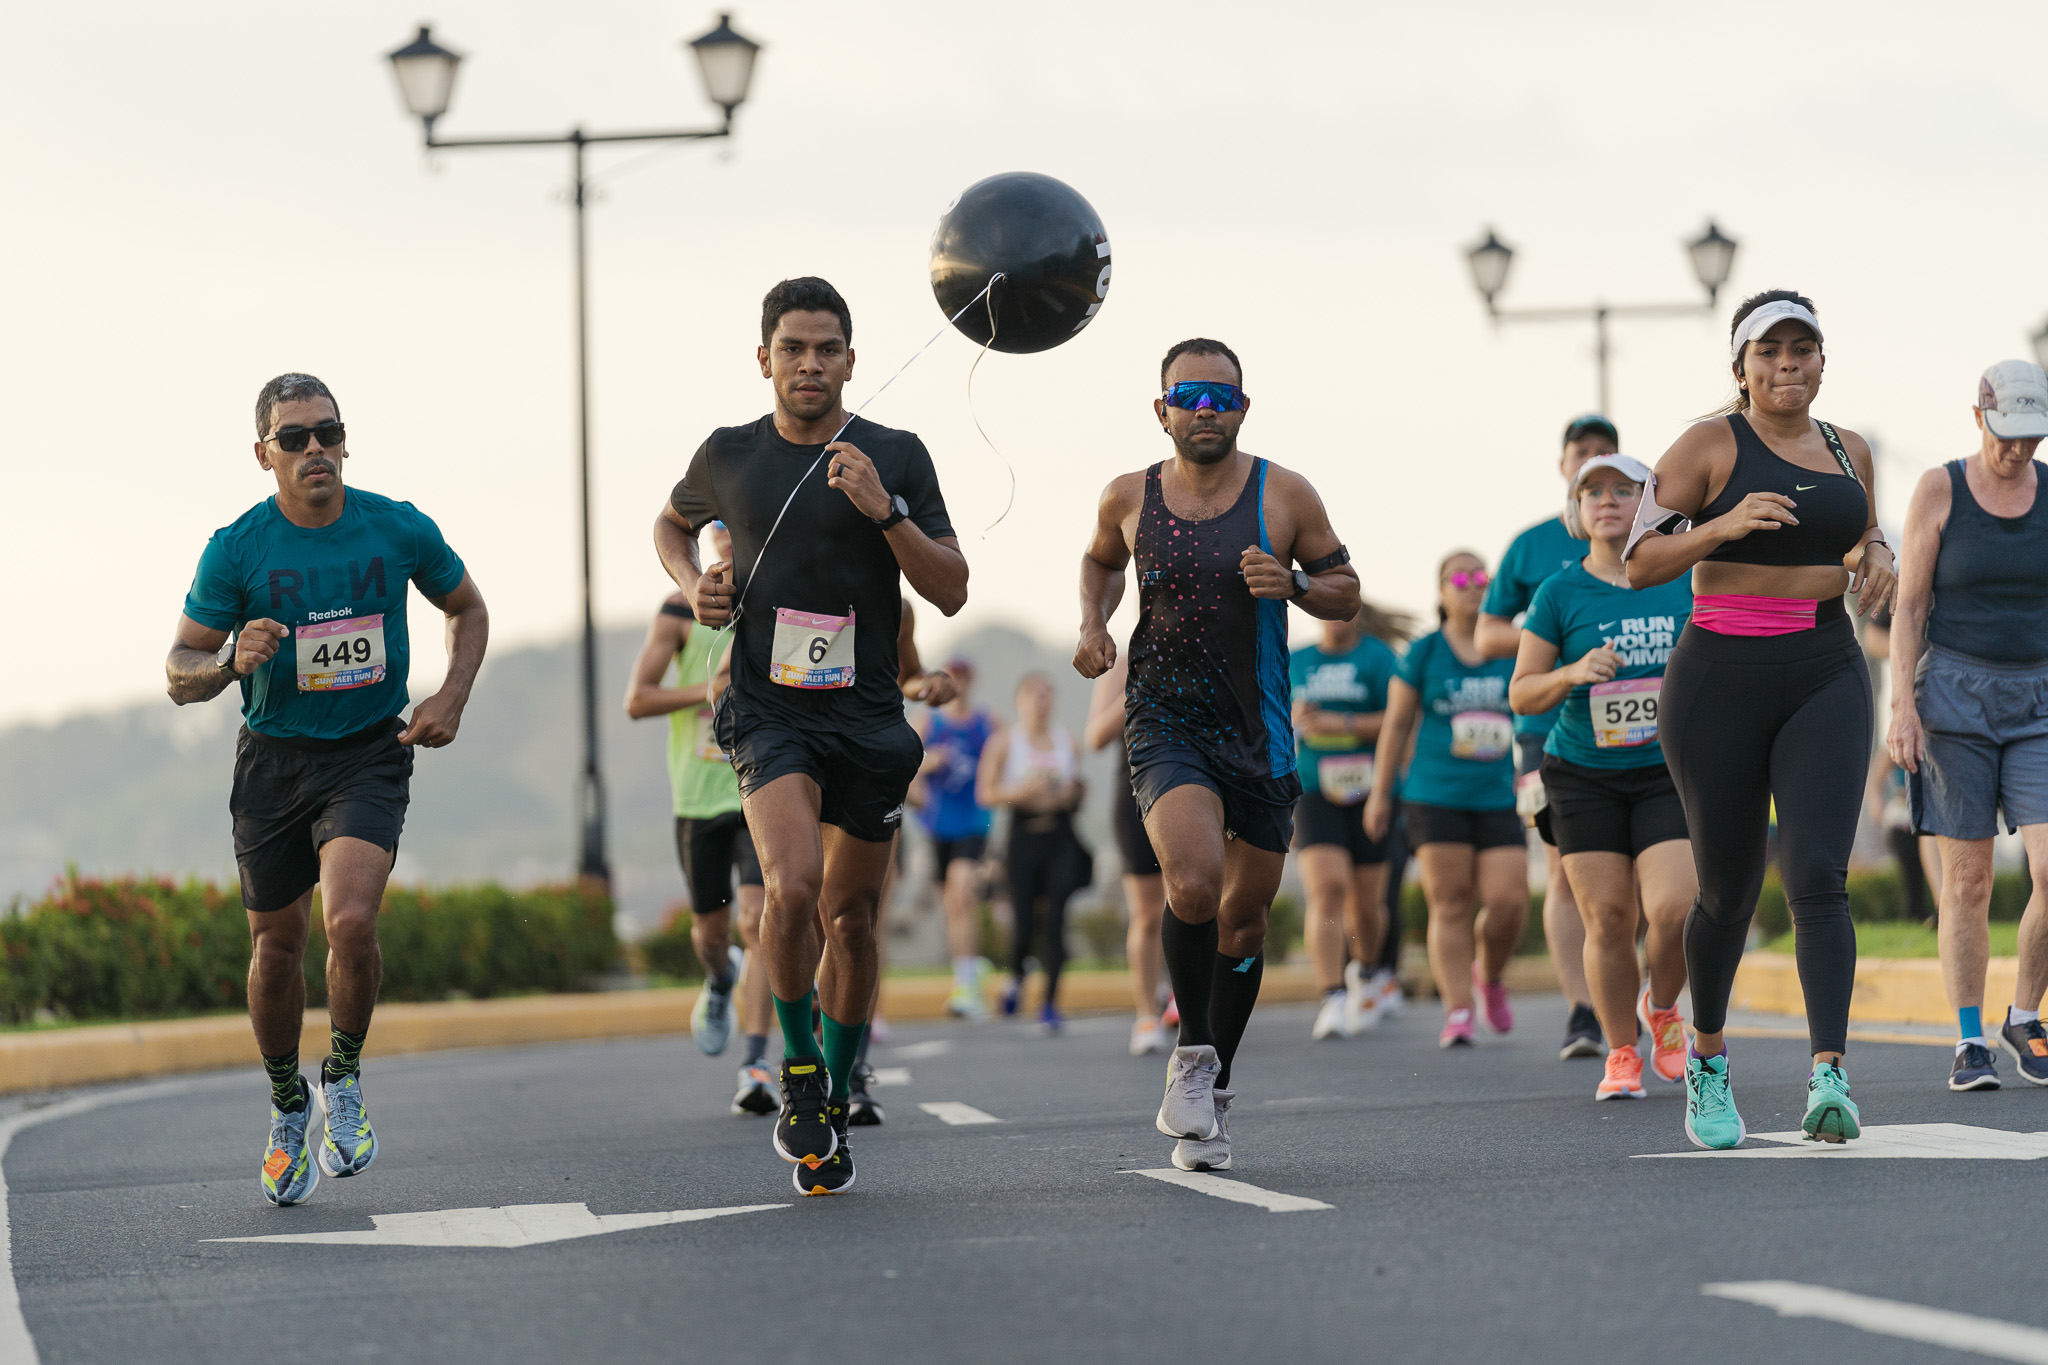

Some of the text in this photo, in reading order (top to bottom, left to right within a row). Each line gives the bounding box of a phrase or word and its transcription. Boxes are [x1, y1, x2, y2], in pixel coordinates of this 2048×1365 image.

[1836, 449, 1857, 480] PRO
[308, 606, 353, 621] Reebok
[1621, 615, 1675, 635] RUN
[808, 636, 829, 665] 6
[1602, 631, 1673, 652] YOUR
[311, 637, 371, 668] 449
[314, 674, 353, 685] SUMMER
[354, 671, 371, 681] RUN
[785, 670, 824, 683] SUMMER
[824, 673, 841, 682] RUN
[1605, 698, 1658, 724] 529
